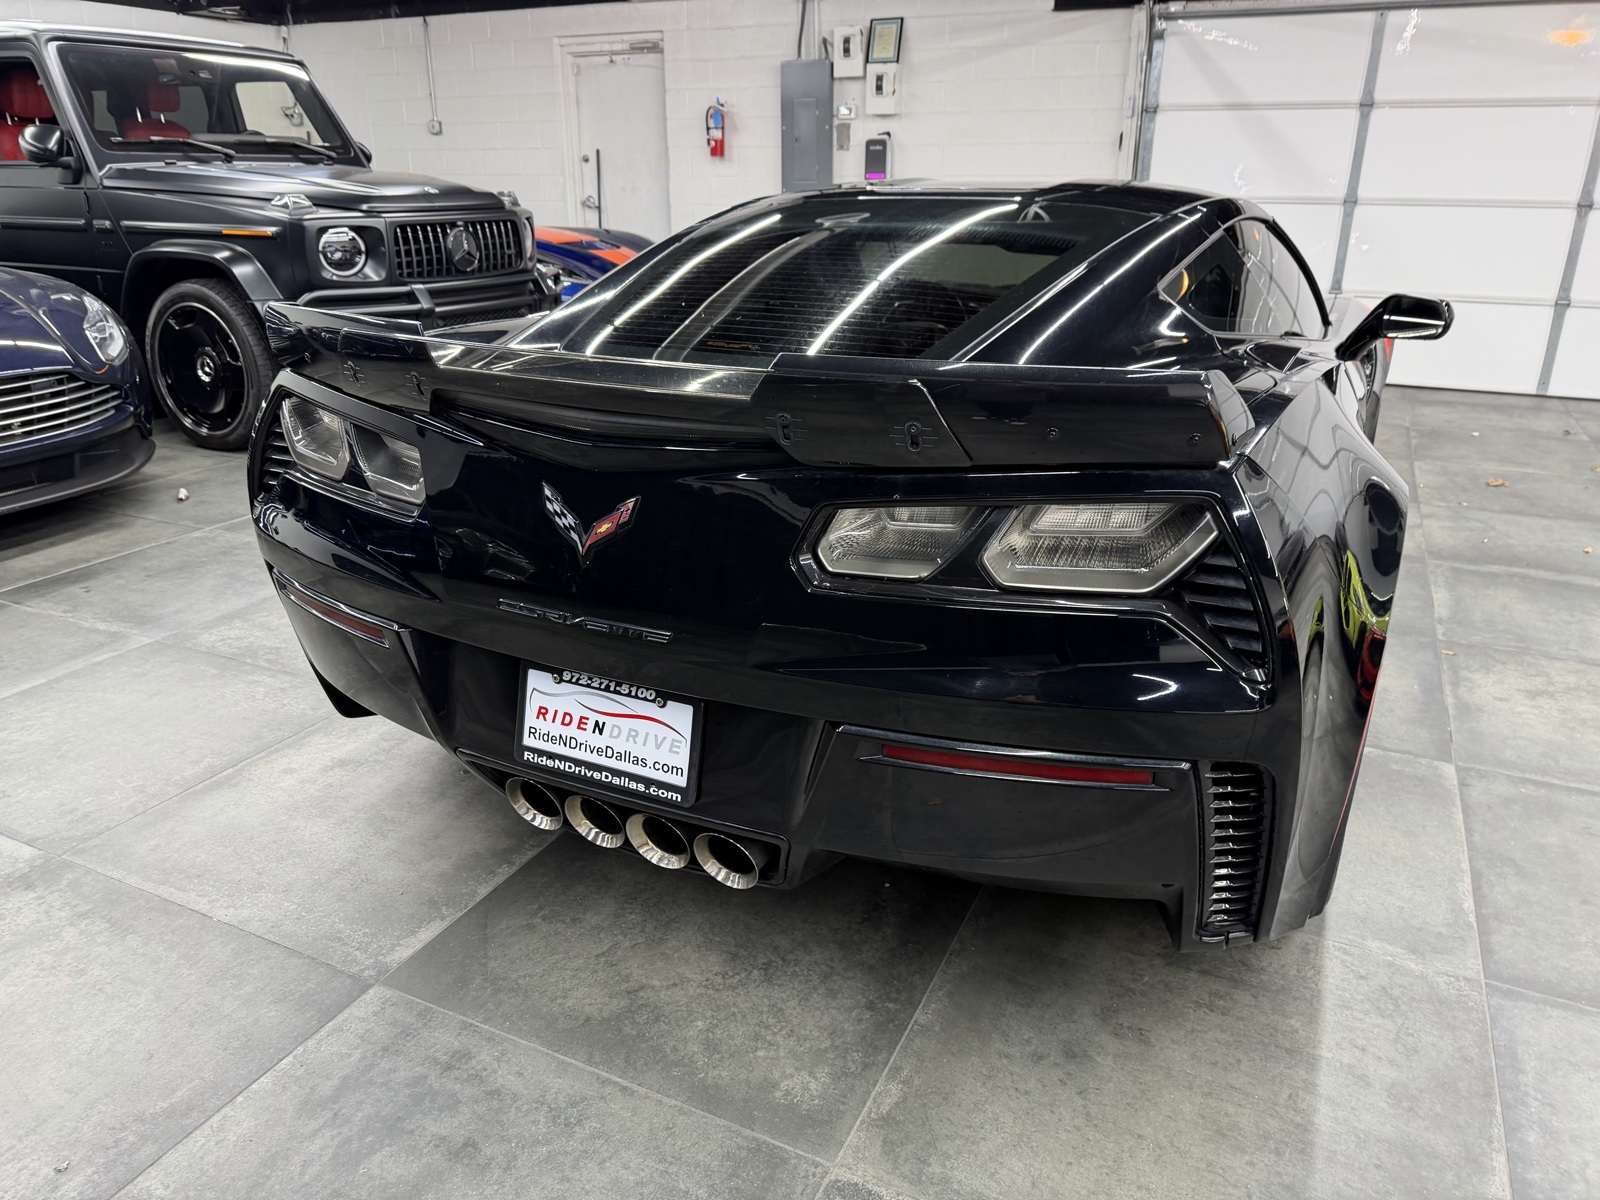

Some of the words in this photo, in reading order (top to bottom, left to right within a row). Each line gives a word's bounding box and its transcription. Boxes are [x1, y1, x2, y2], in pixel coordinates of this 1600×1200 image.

[561, 671, 656, 701] 972-271-5100
[523, 751, 682, 802] RideNDriveDallas.com
[528, 726, 684, 777] RideNDriveDallas.com
